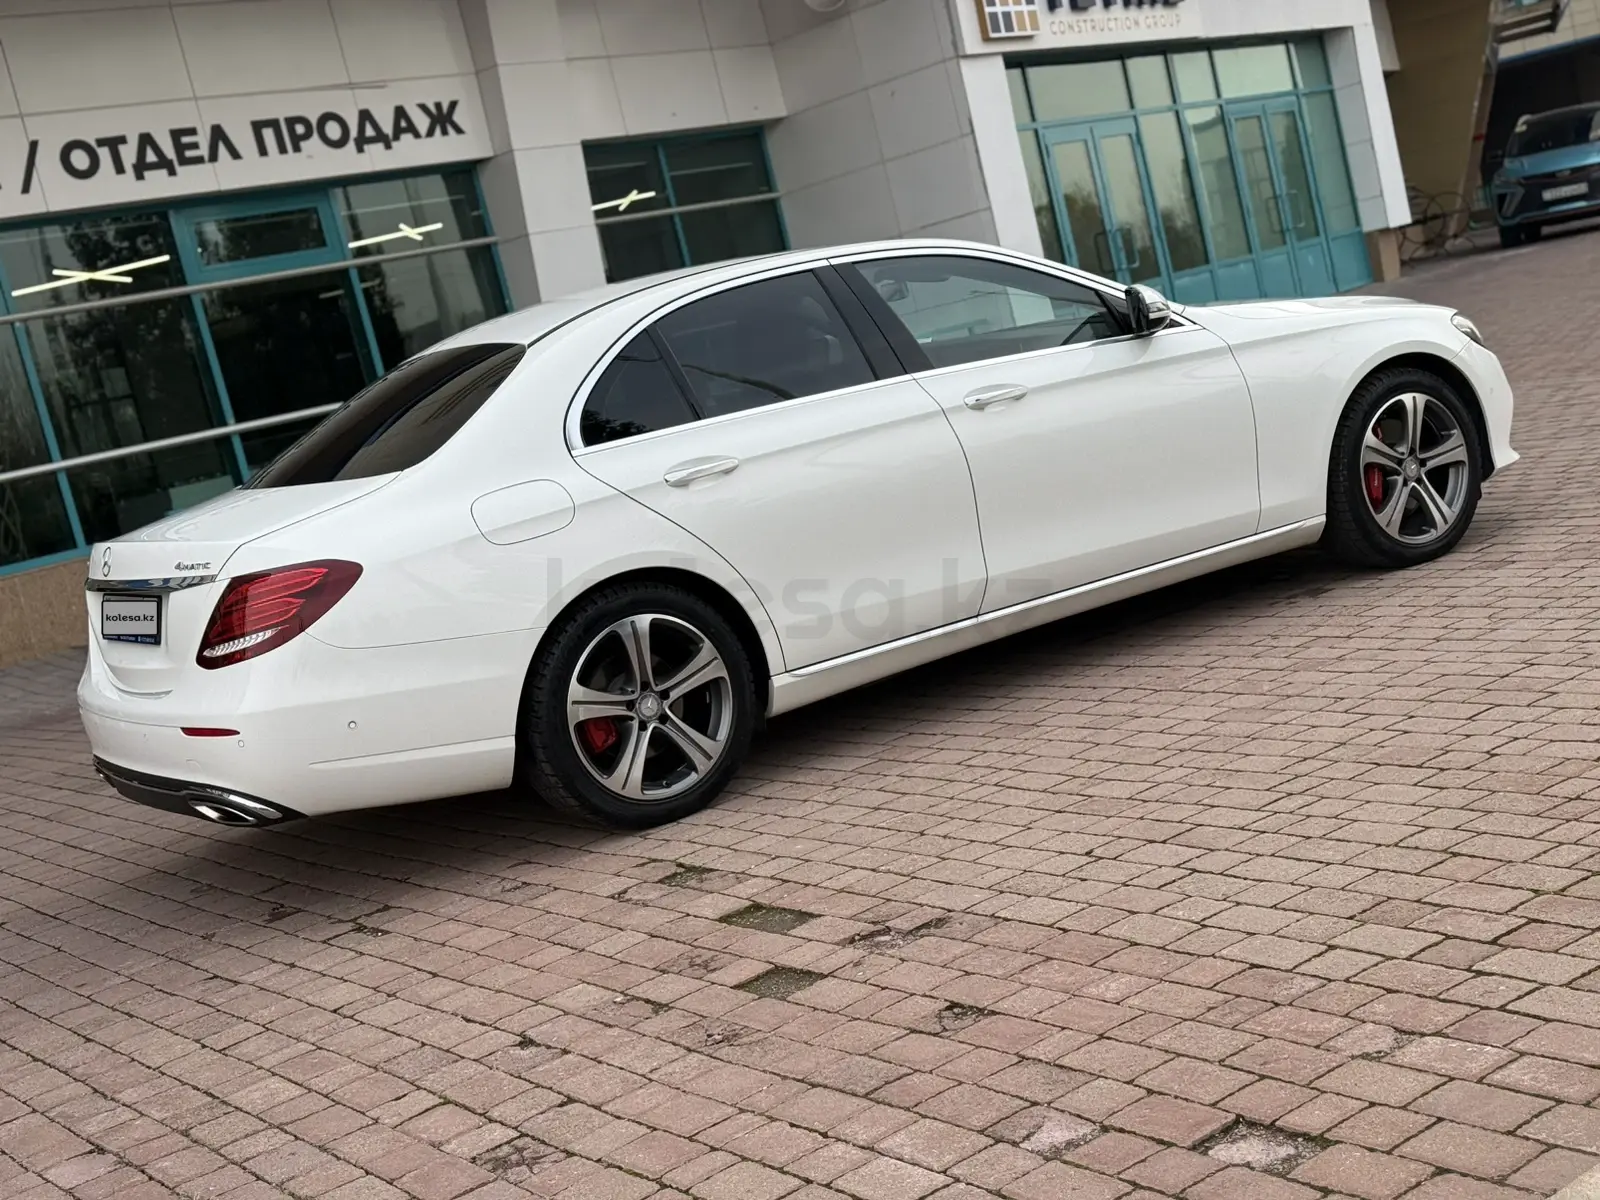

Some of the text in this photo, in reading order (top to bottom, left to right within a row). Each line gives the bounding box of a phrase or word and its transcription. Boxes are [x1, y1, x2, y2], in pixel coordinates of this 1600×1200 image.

[1049, 14, 1182, 35] CONSTRUCTION GROUP
[59, 123, 243, 181] ОТДЕЛ
[250, 100, 466, 157] ПРОДАЖ
[174, 561, 211, 572] 4MATIC
